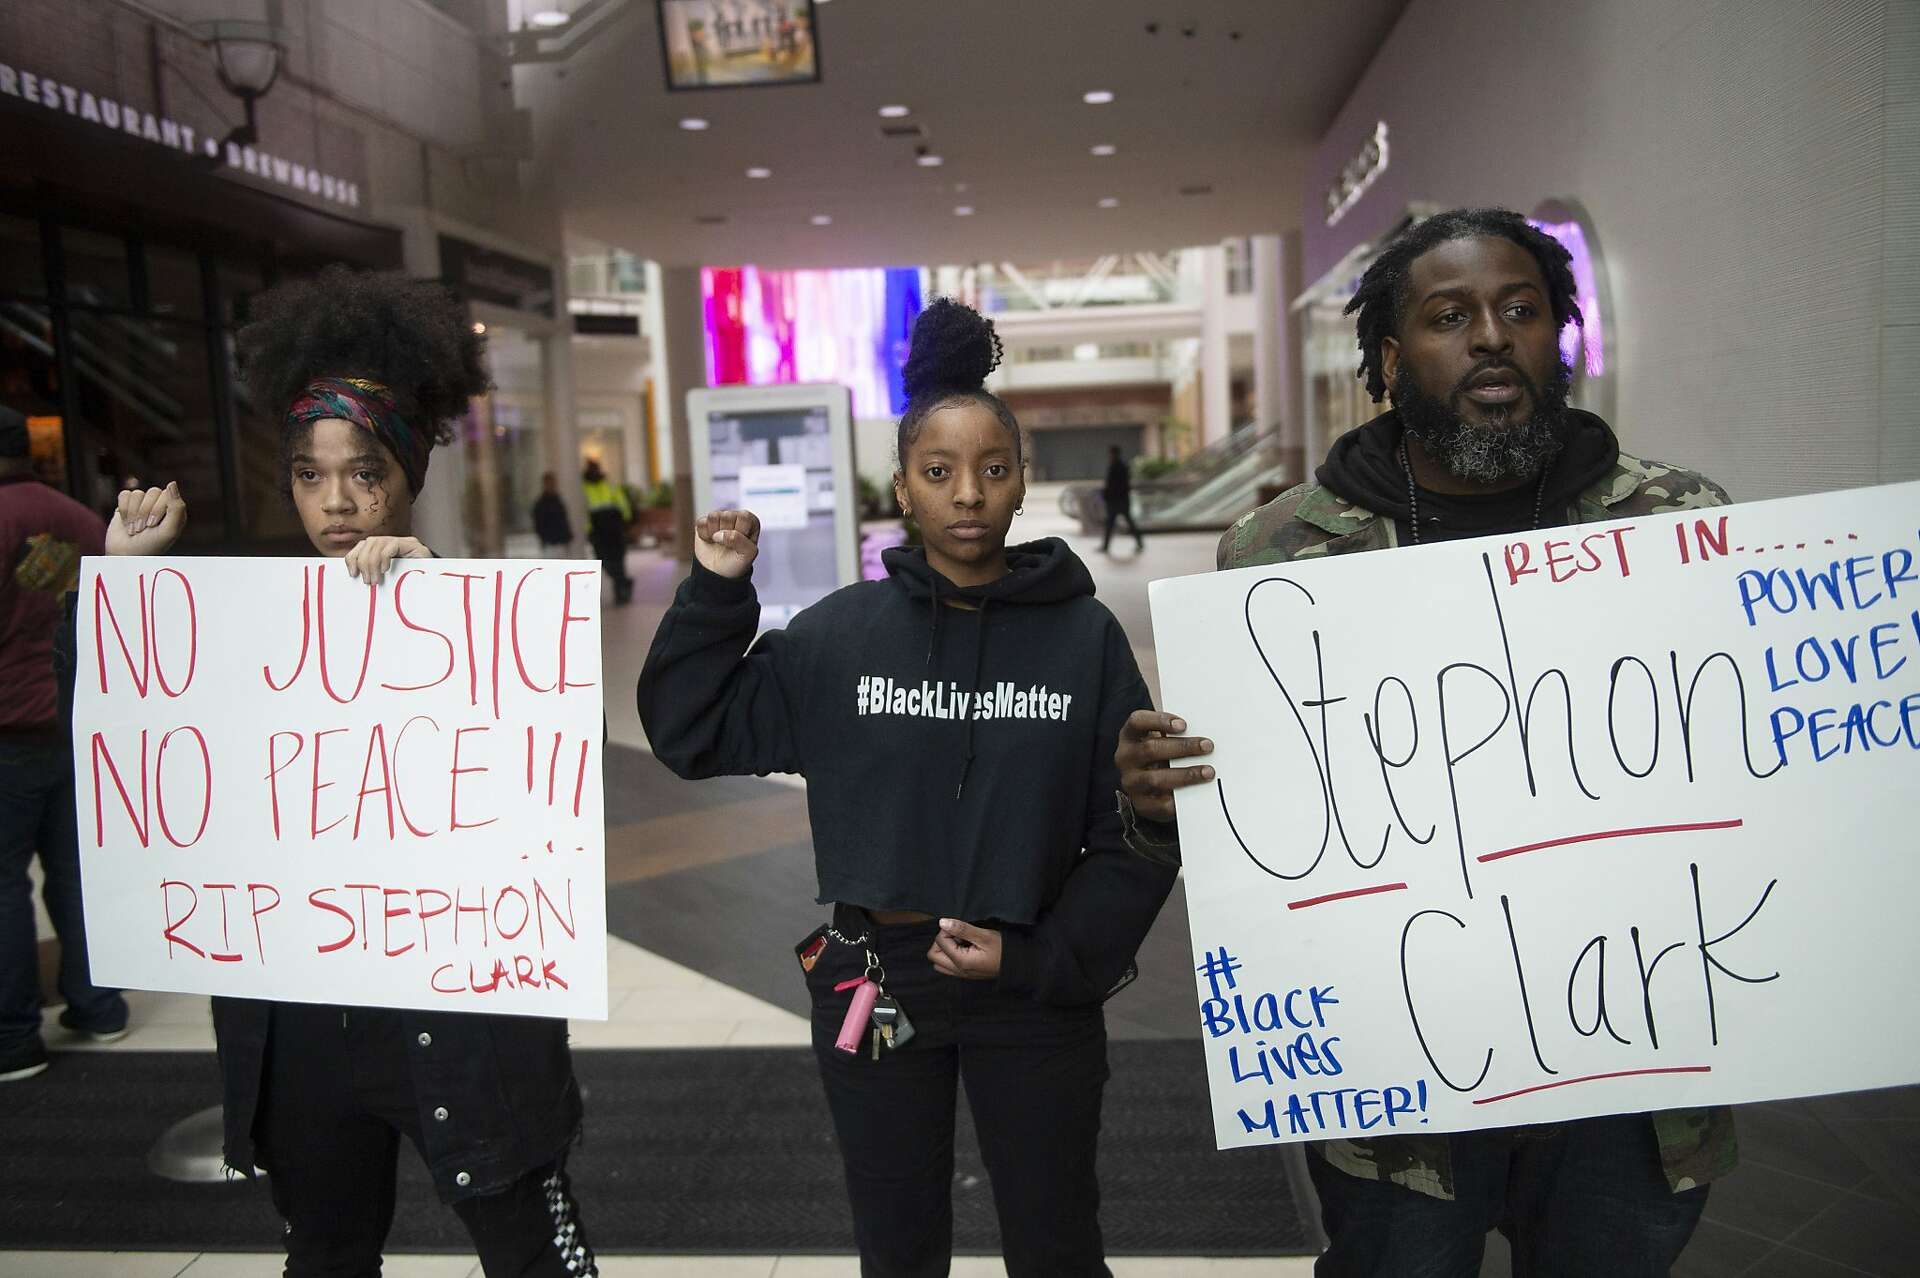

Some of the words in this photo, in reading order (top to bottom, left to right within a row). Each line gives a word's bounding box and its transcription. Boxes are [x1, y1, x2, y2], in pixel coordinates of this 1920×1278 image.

[0, 62, 196, 154] RESTAURANT
[1503, 526, 1635, 586] REST
[1736, 528, 1920, 626] POWER
[96, 567, 197, 698] NO
[263, 563, 596, 719] JUSTICE
[856, 675, 1073, 722] #BlackLivesMatter
[1217, 552, 1784, 899] Stephon
[1770, 692, 1920, 767] PEACE
[92, 725, 212, 848] NO
[160, 877, 281, 965] RIP
[308, 877, 576, 957] STEPHON
[430, 954, 569, 994] CLARK
[1196, 946, 1243, 1000] #
[1400, 862, 1780, 1092] Clark
[1200, 985, 1340, 1039] Black
[1228, 1032, 1344, 1086] Lives
[1236, 1078, 1429, 1138] MATTER!
